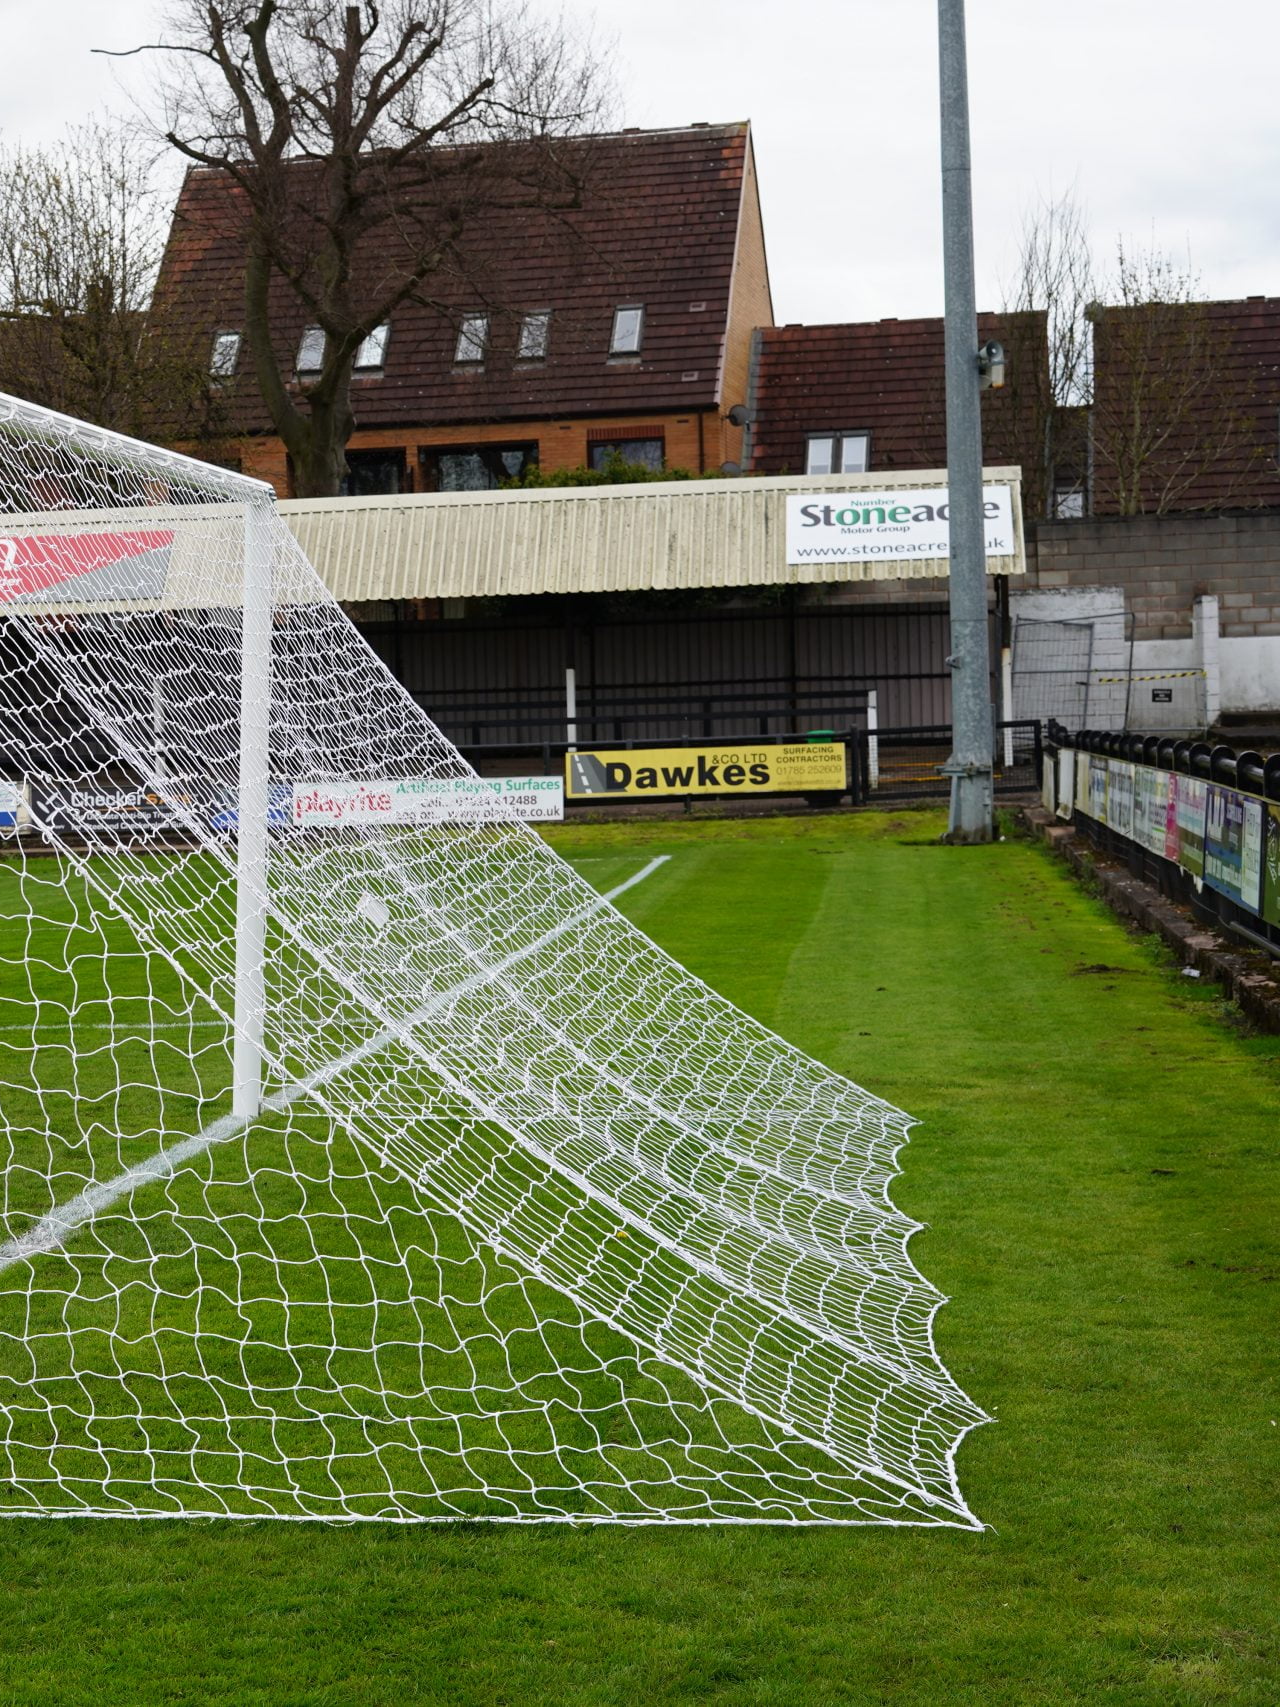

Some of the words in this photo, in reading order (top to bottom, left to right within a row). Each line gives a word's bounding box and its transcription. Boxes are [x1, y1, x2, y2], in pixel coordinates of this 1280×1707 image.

[851, 498, 896, 507] Number
[800, 502, 1000, 527] Stoneace
[841, 525, 873, 535] Motor
[876, 525, 910, 534] Group
[797, 537, 1004, 557] www.stoneacreuk
[783, 746, 834, 755] SURFACING
[744, 753, 767, 764] LTD
[776, 755, 842, 764] CONTRACTORS
[606, 755, 770, 790] Dawkes
[776, 766, 805, 776] 01785
[506, 779, 560, 791] Surfaces
